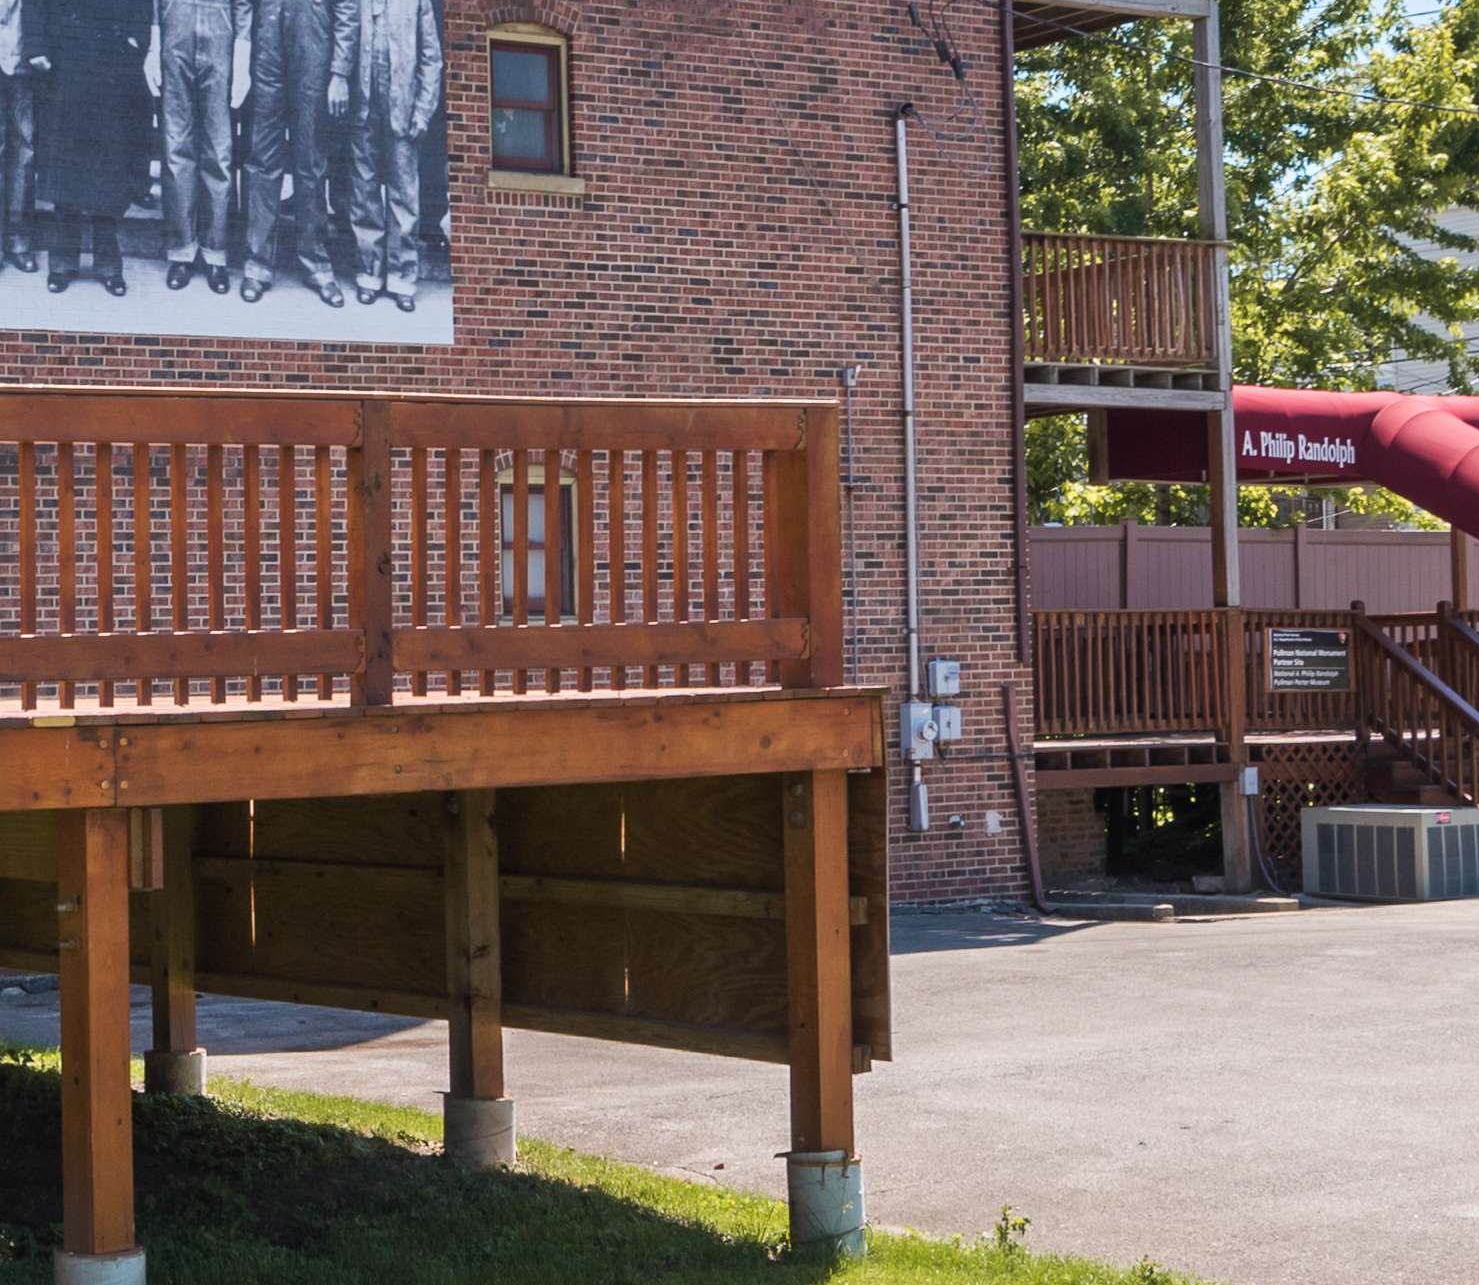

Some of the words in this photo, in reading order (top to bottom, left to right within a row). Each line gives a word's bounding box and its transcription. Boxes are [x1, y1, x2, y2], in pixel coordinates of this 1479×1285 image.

[1242, 431, 1257, 456] A.
[1259, 431, 1295, 464] Philip
[1298, 434, 1356, 468] Randolph
